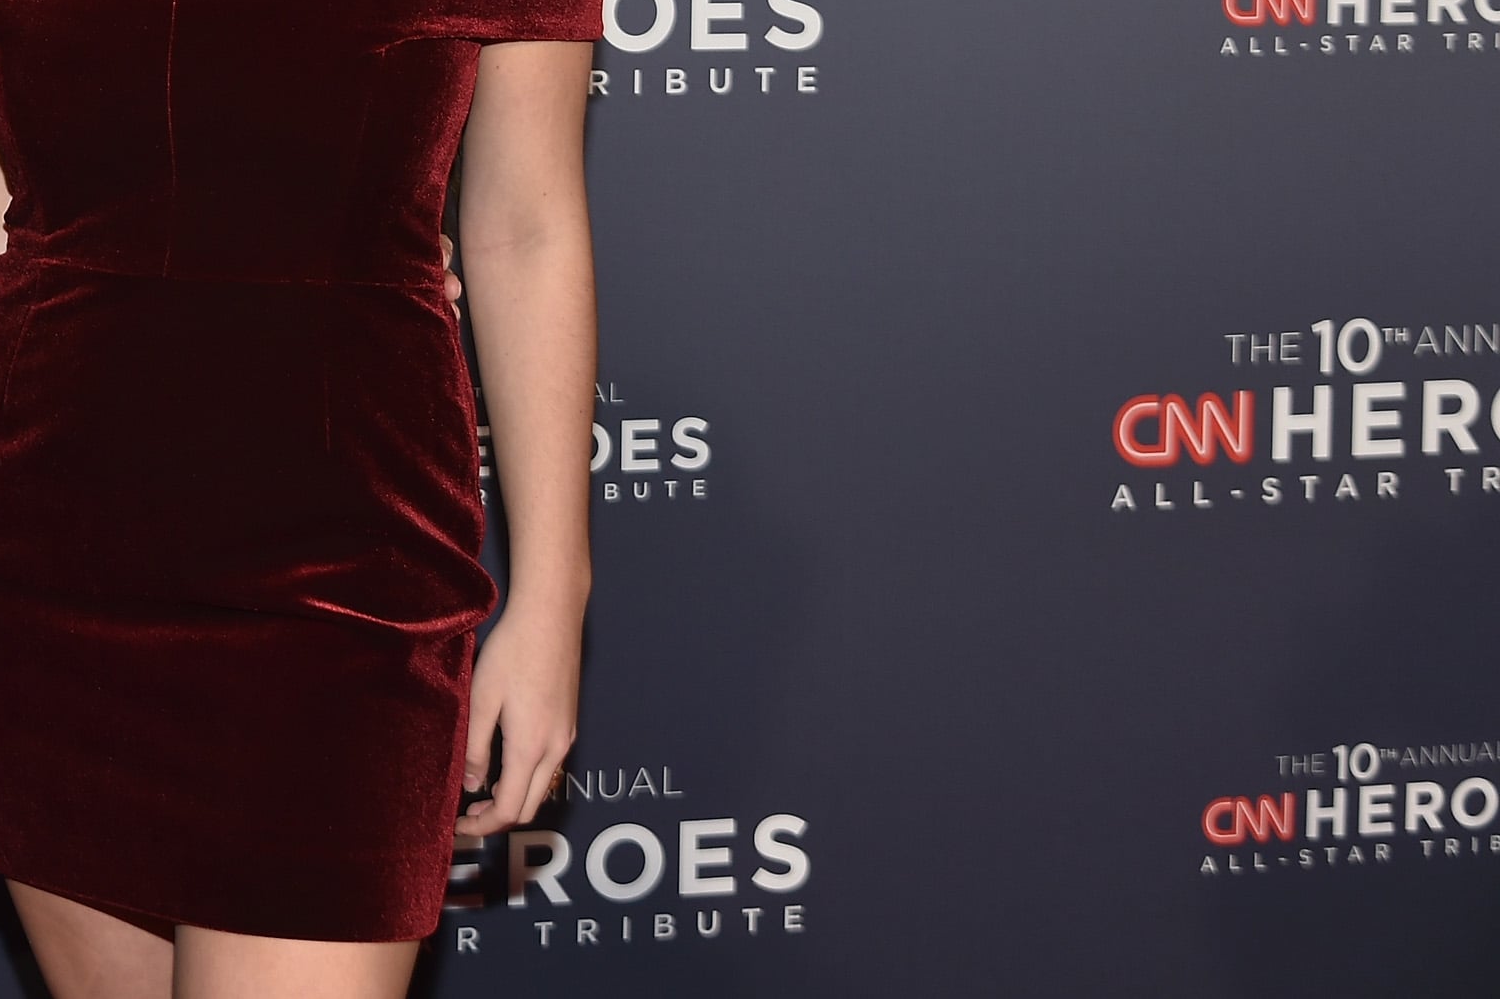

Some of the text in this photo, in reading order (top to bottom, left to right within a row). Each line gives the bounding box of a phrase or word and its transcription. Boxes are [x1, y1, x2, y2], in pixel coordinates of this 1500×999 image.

[1221, 34, 1413, 55] ALL-STAR
[590, 67, 817, 95] RIBUTE
[1225, 332, 1300, 362] THE
[1414, 323, 1500, 355] ANN
[1112, 380, 1500, 468] CNN HER
[605, 480, 705, 500] BUTE
[1111, 472, 1398, 510] ALL-STAR
[1276, 754, 1324, 775] THE
[1401, 741, 1500, 767] ANNUA
[567, 766, 682, 800] NUAL
[1202, 777, 1500, 846] CNN HERO
[1200, 835, 1500, 873] ALL-STAR TRIB
[534, 905, 805, 946] TRIBUTE
